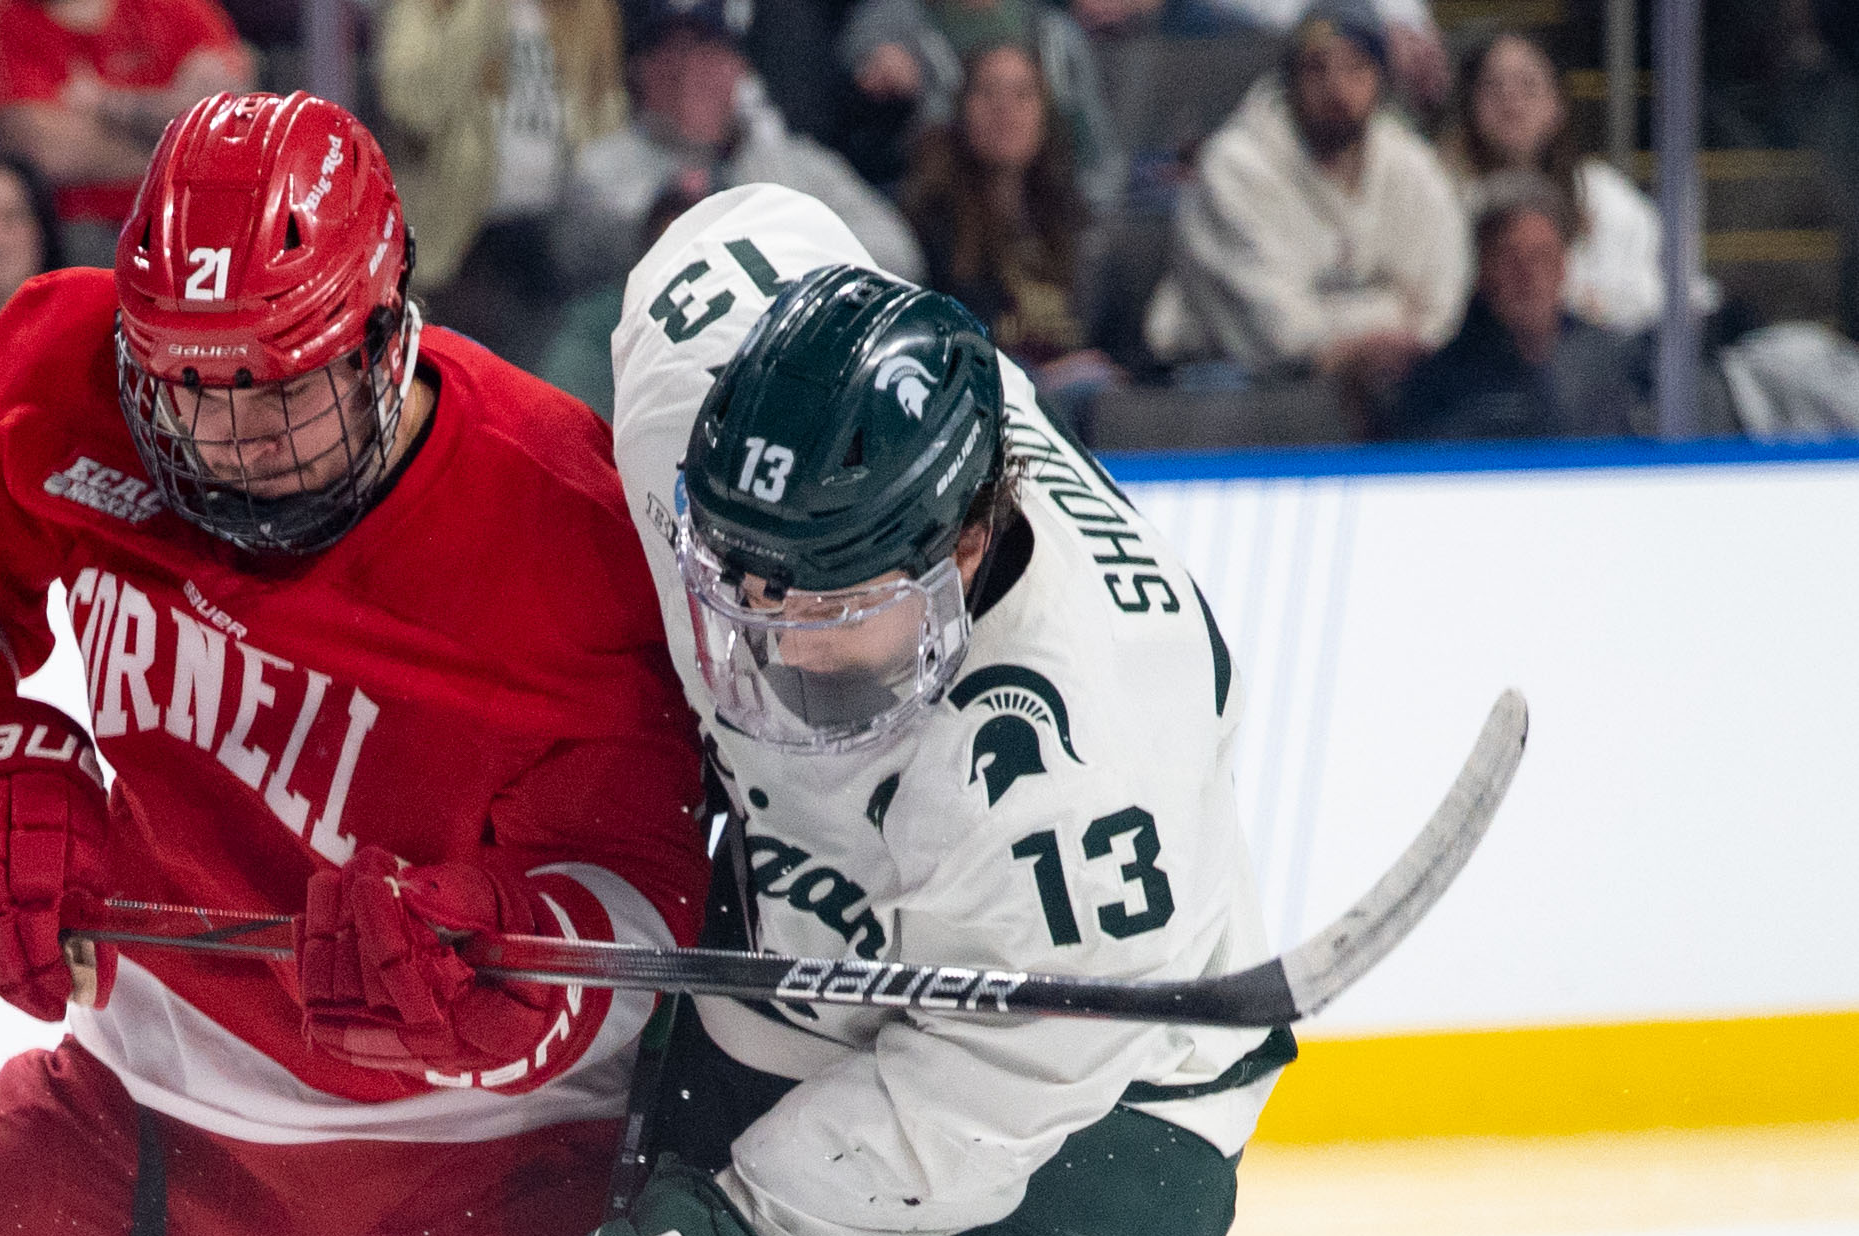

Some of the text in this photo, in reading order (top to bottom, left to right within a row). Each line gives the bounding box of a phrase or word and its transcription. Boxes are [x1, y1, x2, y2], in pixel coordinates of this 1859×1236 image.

[307, 134, 343, 212] Big Red
[184, 246, 232, 301] 21
[648, 237, 779, 345] 13
[738, 436, 795, 503] 13
[66, 566, 381, 870] CORNELL
[1010, 805, 1177, 948] 13
[775, 956, 1028, 1012] BAUER
